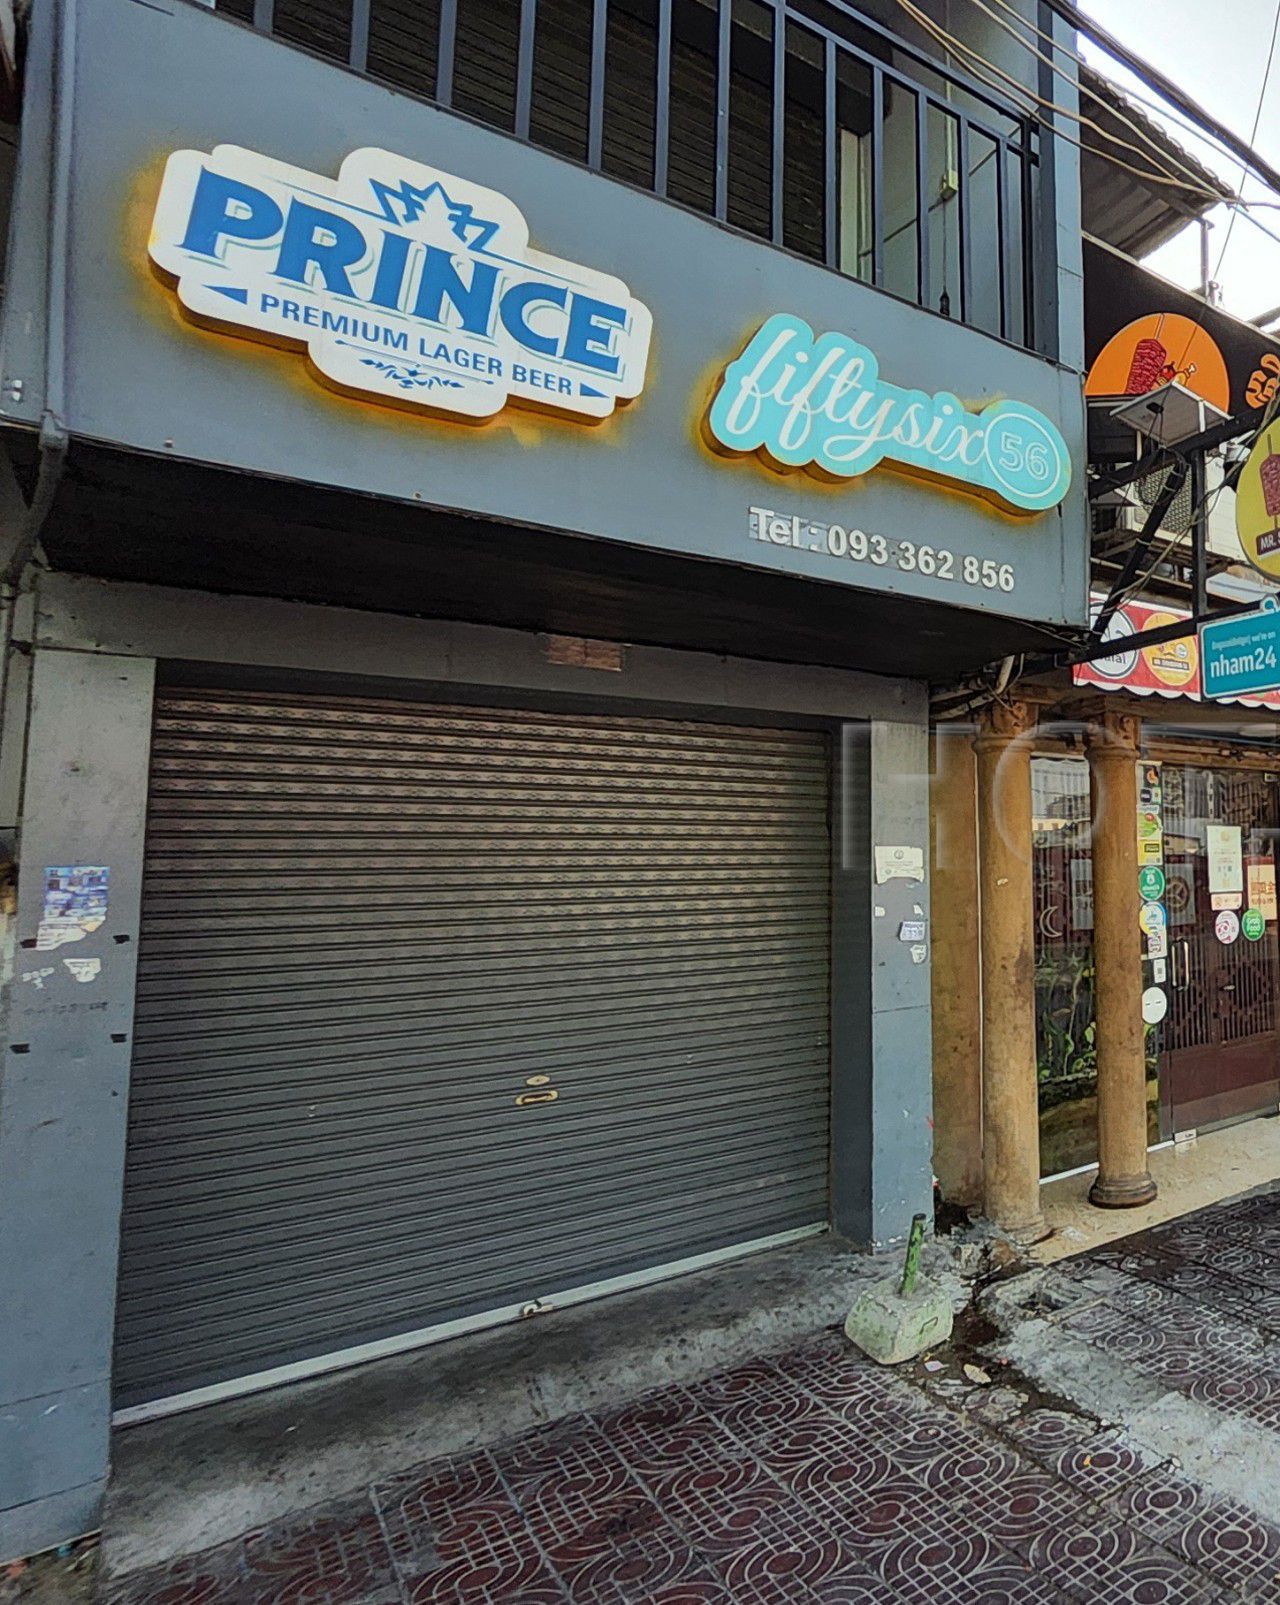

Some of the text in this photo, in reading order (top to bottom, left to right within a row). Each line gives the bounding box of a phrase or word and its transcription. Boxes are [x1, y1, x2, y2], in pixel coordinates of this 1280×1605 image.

[176, 166, 628, 375] PRINCE
[260, 292, 572, 395] PREMIUM LAGER BEER
[726, 329, 991, 466] fiftysix
[1000, 432, 1049, 480] 56
[828, 525, 888, 565] 093
[899, 541, 954, 579] 362
[964, 556, 1014, 592] 856
[1260, 534, 1276, 551] MR.
[1210, 645, 1277, 679] nham24
